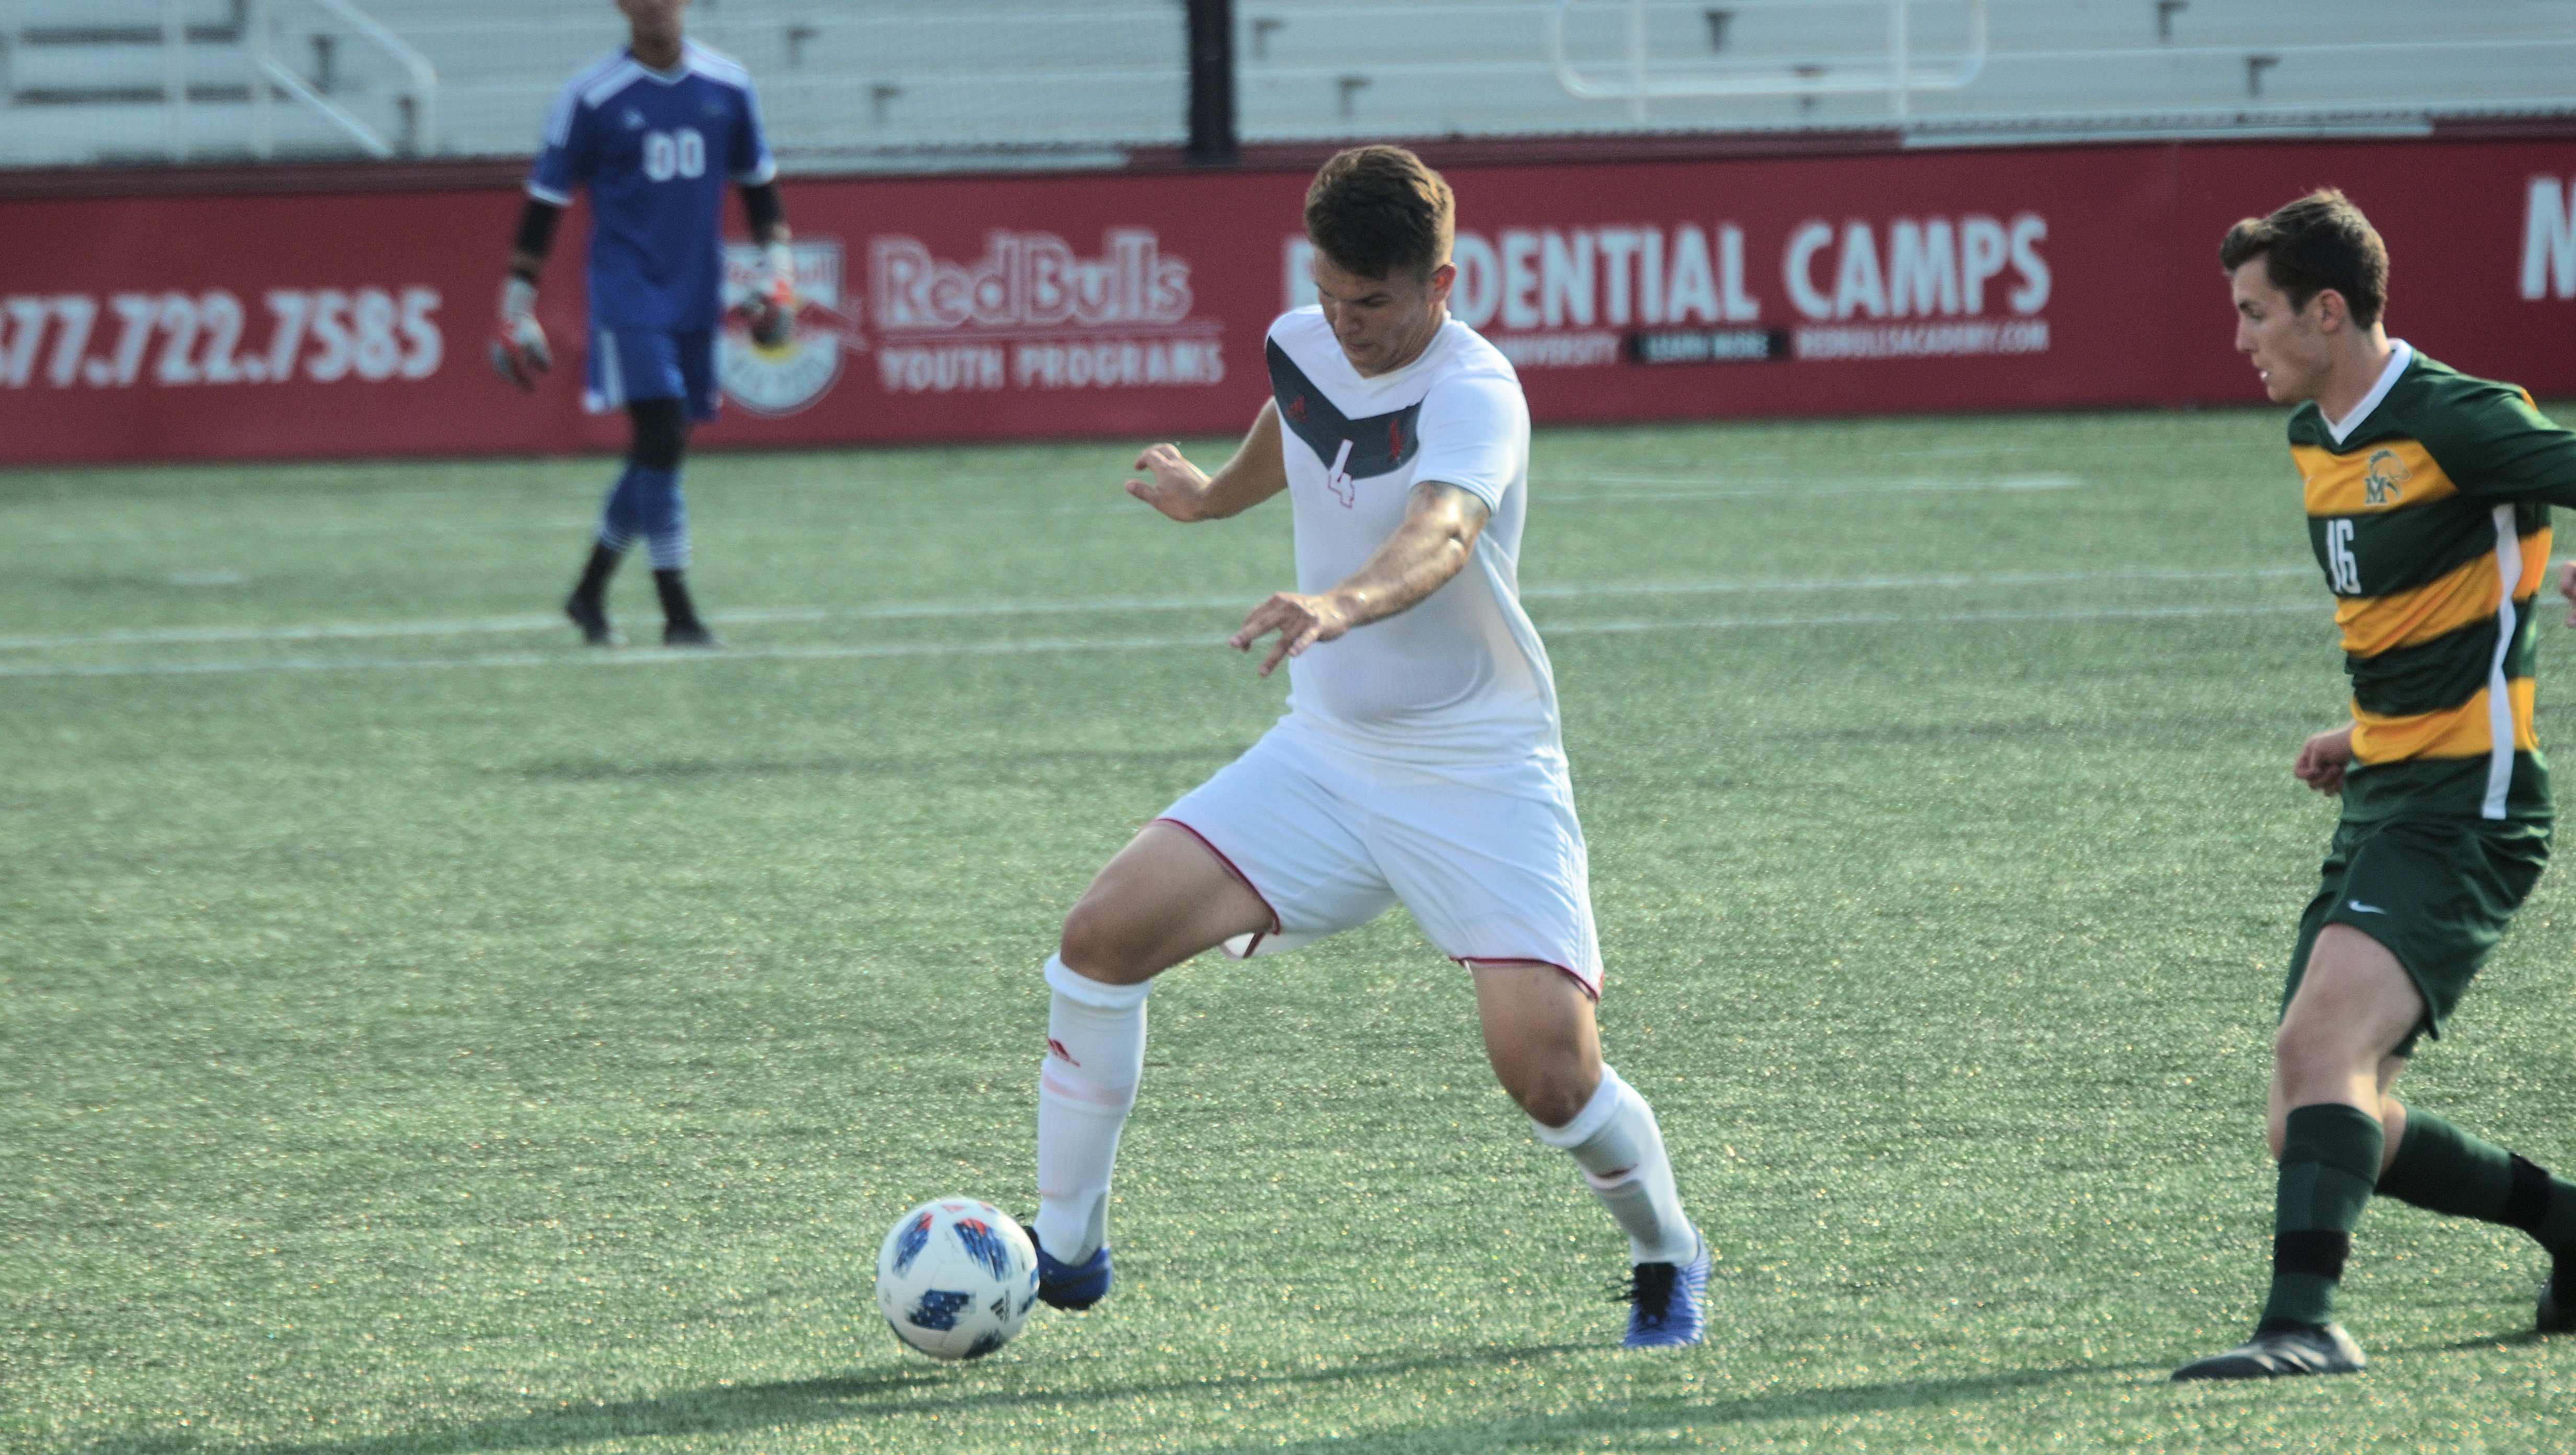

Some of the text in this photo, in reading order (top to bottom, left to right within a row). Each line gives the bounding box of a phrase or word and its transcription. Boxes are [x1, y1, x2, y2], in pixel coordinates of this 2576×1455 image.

[643, 129, 707, 182] 00
[869, 230, 1194, 329] RedBulls
[1284, 213, 2050, 330] DENTIAL CAMPS
[0, 288, 443, 388] 77.722.7585
[879, 347, 1006, 391] YOUTH
[1015, 343, 1225, 390] PROGRAMS
[2326, 519, 2361, 594] 16
